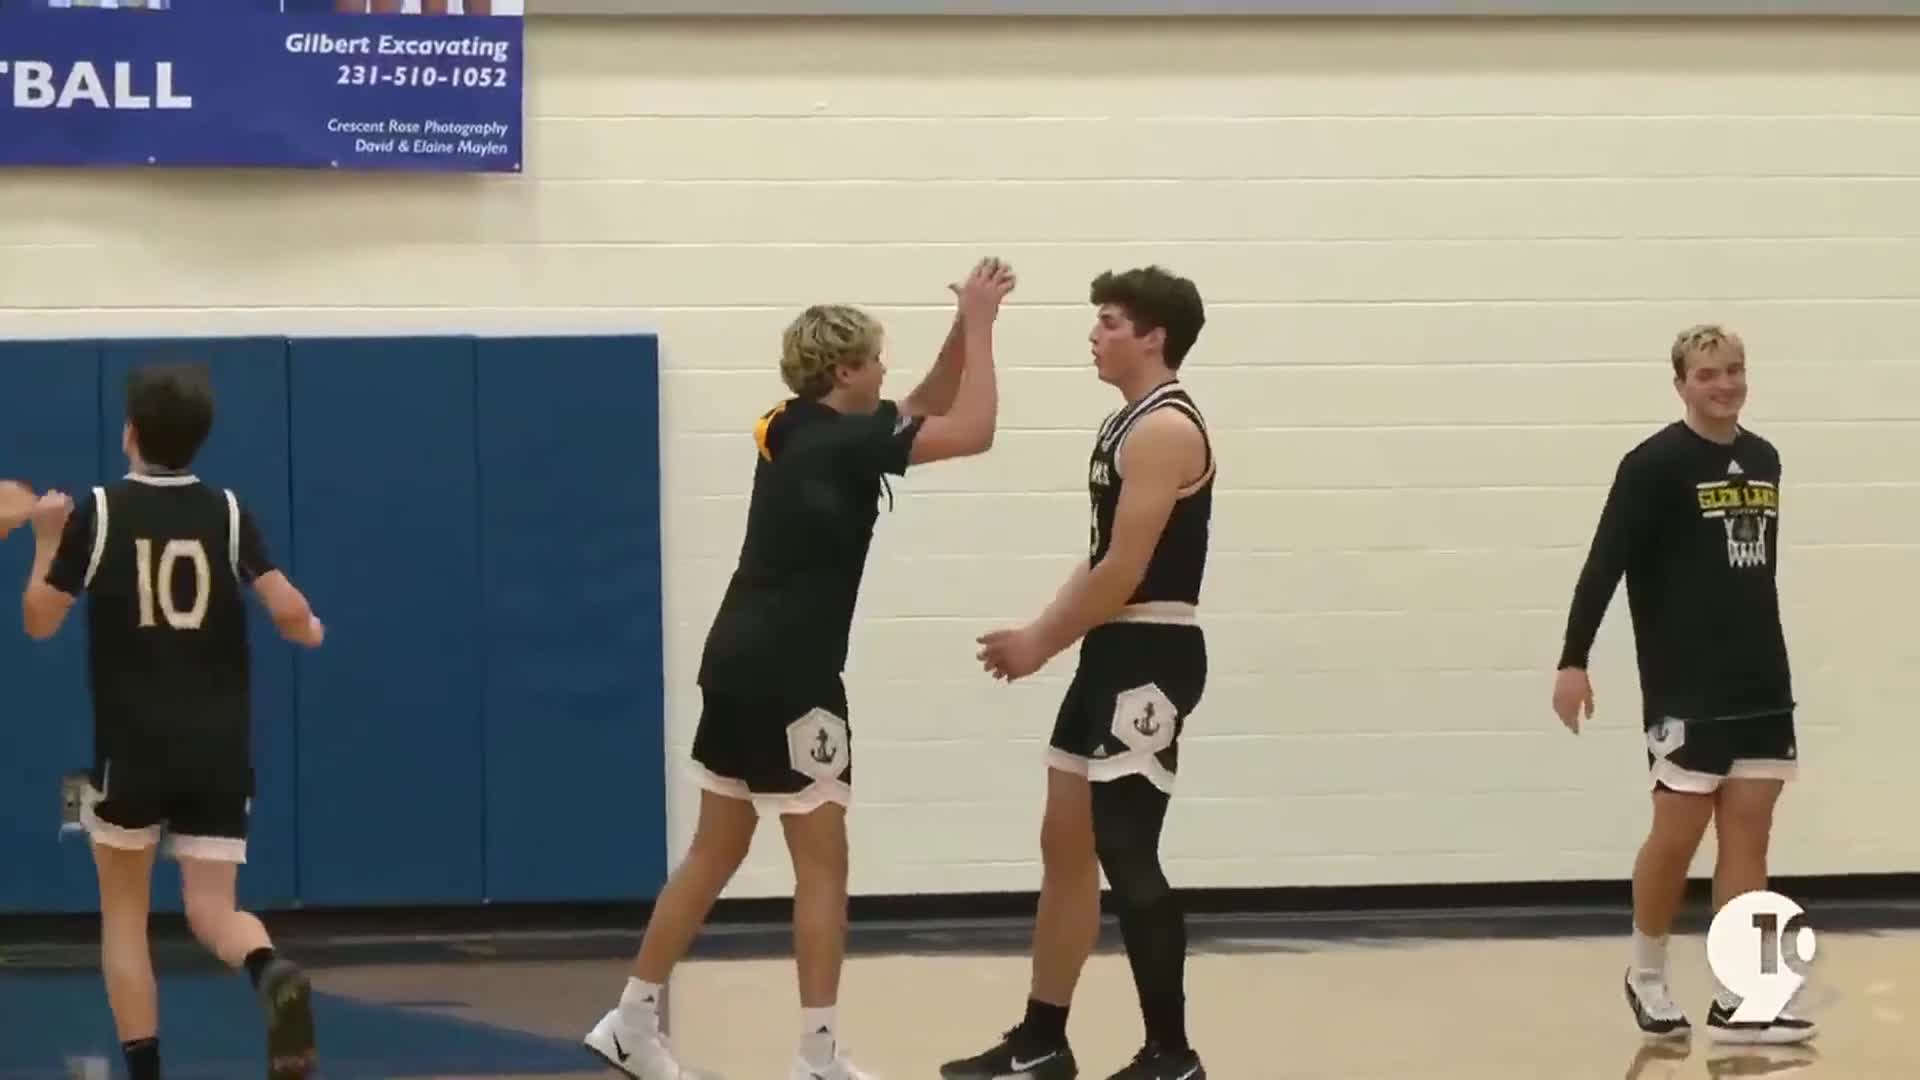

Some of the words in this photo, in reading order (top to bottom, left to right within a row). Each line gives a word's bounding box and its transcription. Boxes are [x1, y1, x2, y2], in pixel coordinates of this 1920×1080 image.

[286, 34, 370, 54] Gilbert
[378, 35, 509, 62] Excavating
[0, 60, 193, 109] BALL
[337, 65, 508, 88] 231-510-1052
[327, 118, 385, 133] Crescent
[388, 119, 420, 133] Rose
[424, 120, 508, 138] Photography
[355, 138, 394, 153] David
[398, 140, 409, 153] &
[413, 139, 453, 154] Elaine
[457, 141, 508, 157] Maylen
[135, 538, 211, 630] 10
